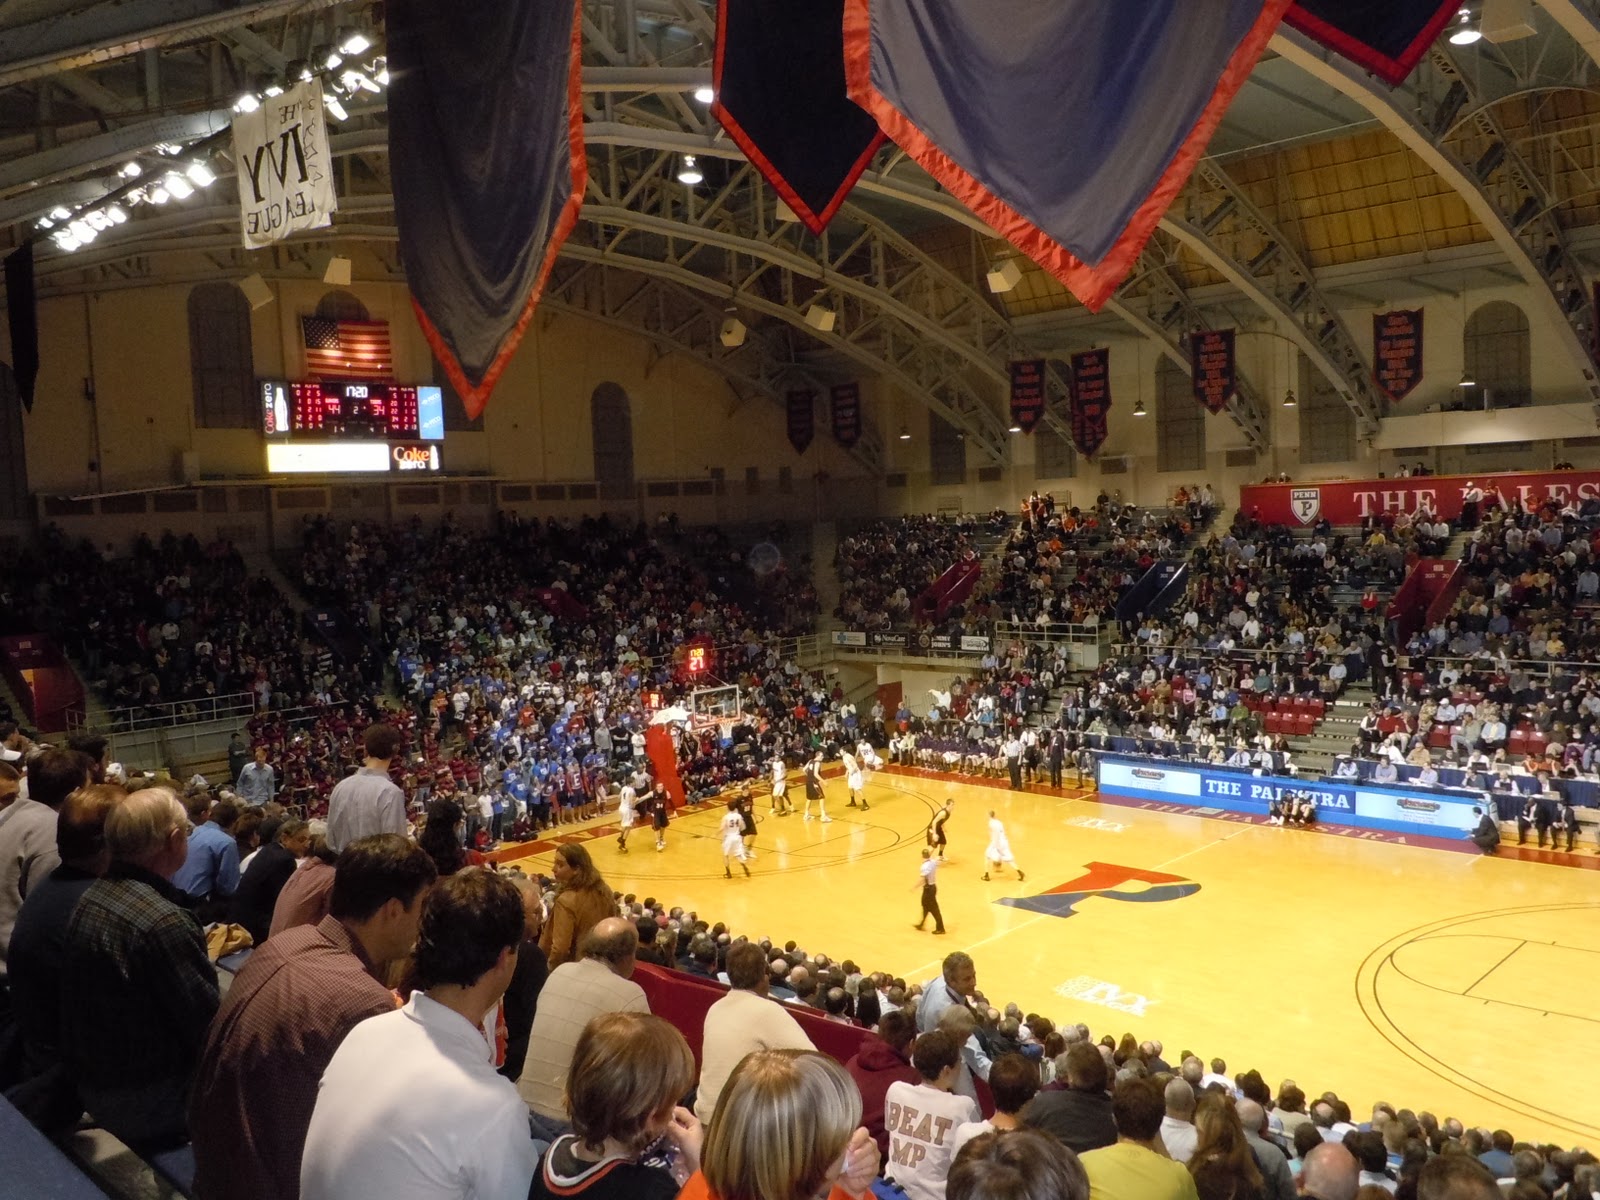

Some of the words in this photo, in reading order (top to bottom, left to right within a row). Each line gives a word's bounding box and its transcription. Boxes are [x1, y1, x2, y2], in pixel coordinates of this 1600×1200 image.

[264, 383, 273, 408] zero
[346, 386, 368, 398] 17:20
[328, 405, 341, 414] 44
[353, 406, 358, 414] 2
[373, 405, 385, 415] 34
[265, 409, 274, 434] Coke
[393, 446, 430, 461] Coke
[1353, 489, 1437, 518] THE
[1459, 482, 1600, 515] PLES
[1300, 501, 1312, 516] P
[690, 656, 704, 670] 27
[559, 780, 565, 791] P
[574, 773, 580, 786] E
[1206, 779, 1242, 796] THE
[1216, 813, 1408, 844] PASTRA
[888, 1102, 954, 1146] BEAT
[892, 1138, 926, 1168] MP
